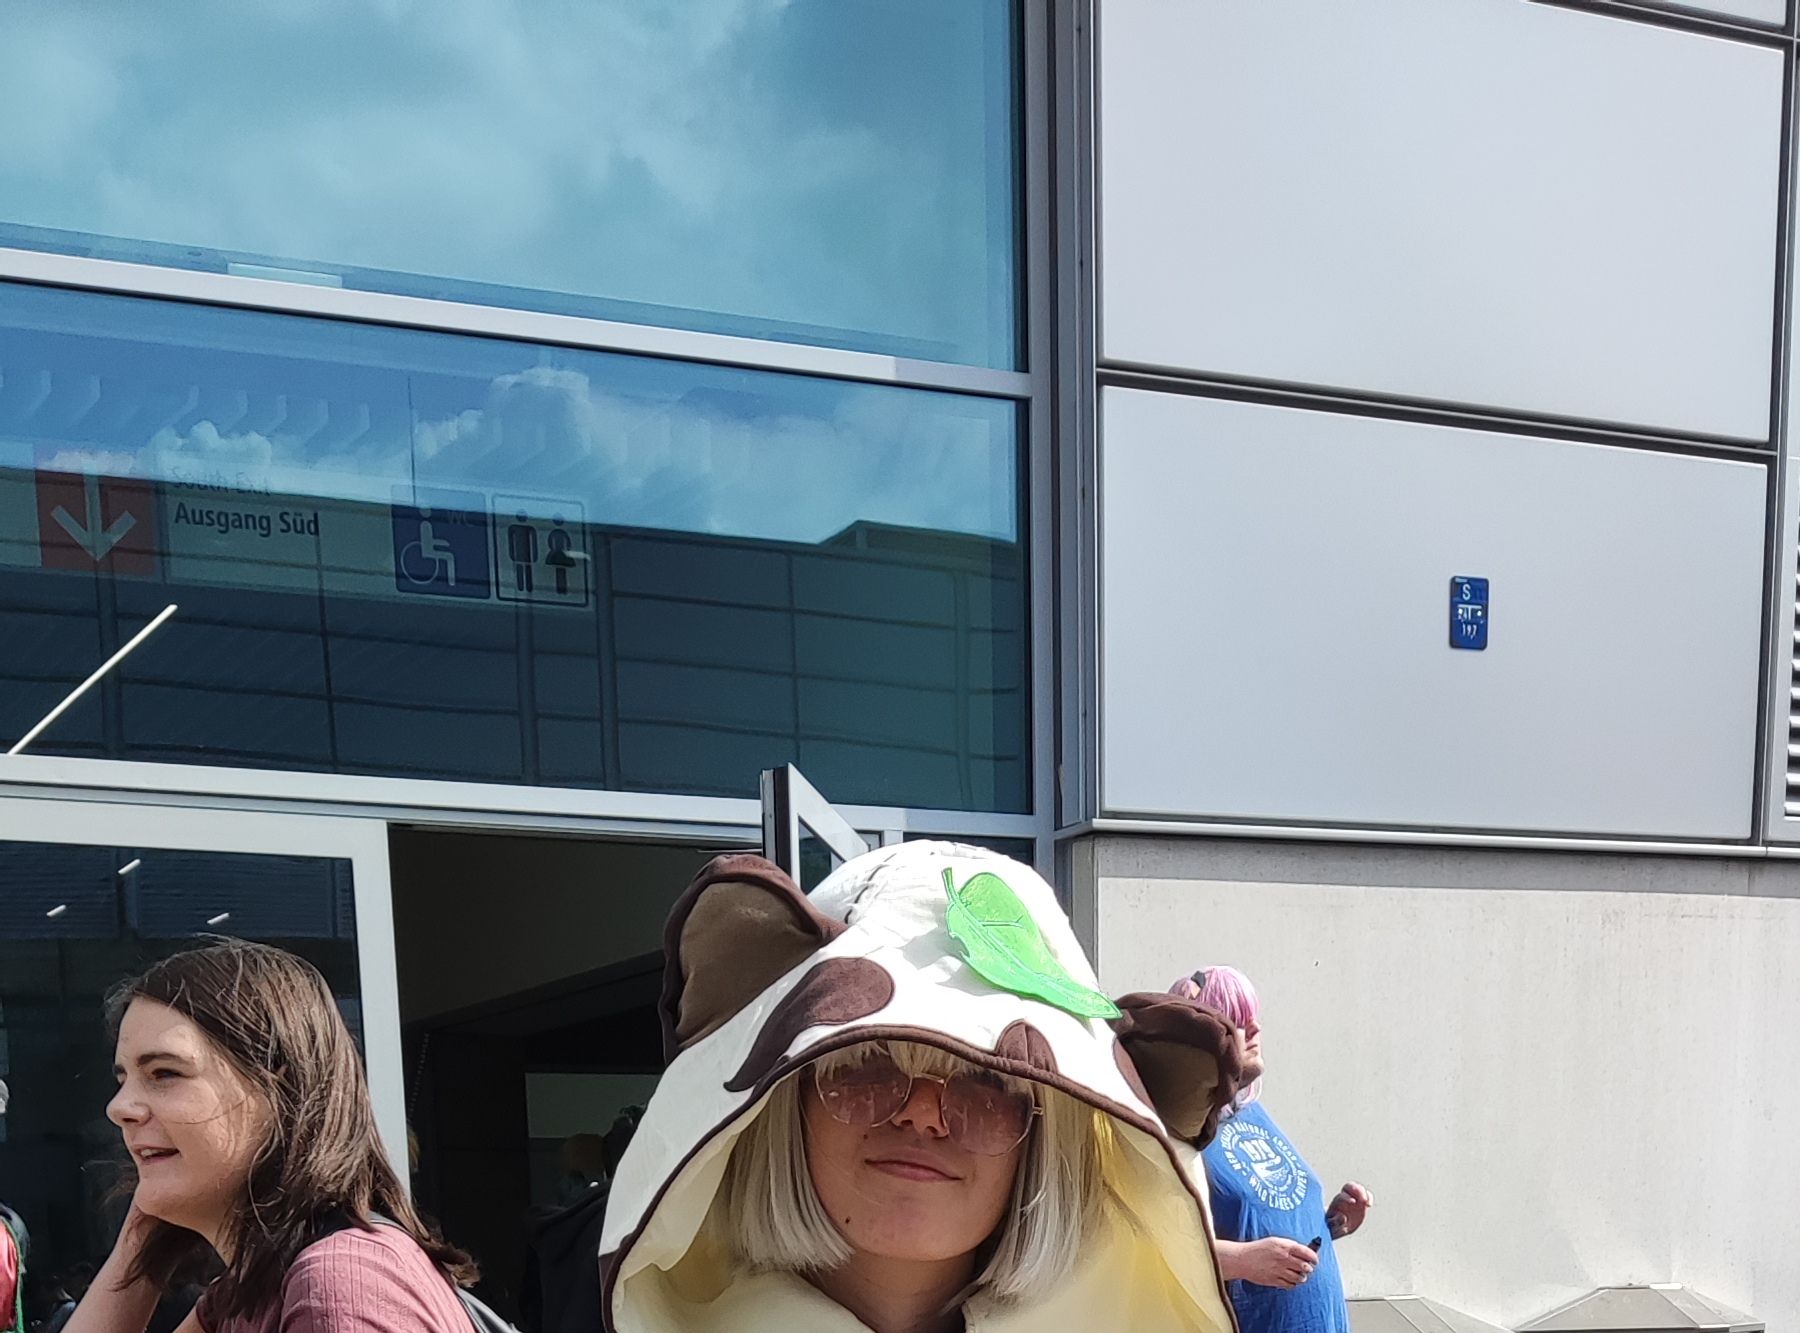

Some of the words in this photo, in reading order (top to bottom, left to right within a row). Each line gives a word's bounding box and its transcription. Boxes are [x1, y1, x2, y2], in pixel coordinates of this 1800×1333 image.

[174, 502, 271, 538] Ausgang
[279, 510, 320, 537] Süd
[1462, 584, 1471, 600] S
[1239, 1139, 1277, 1162] 1979
[1249, 1176, 1268, 1202] WILD
